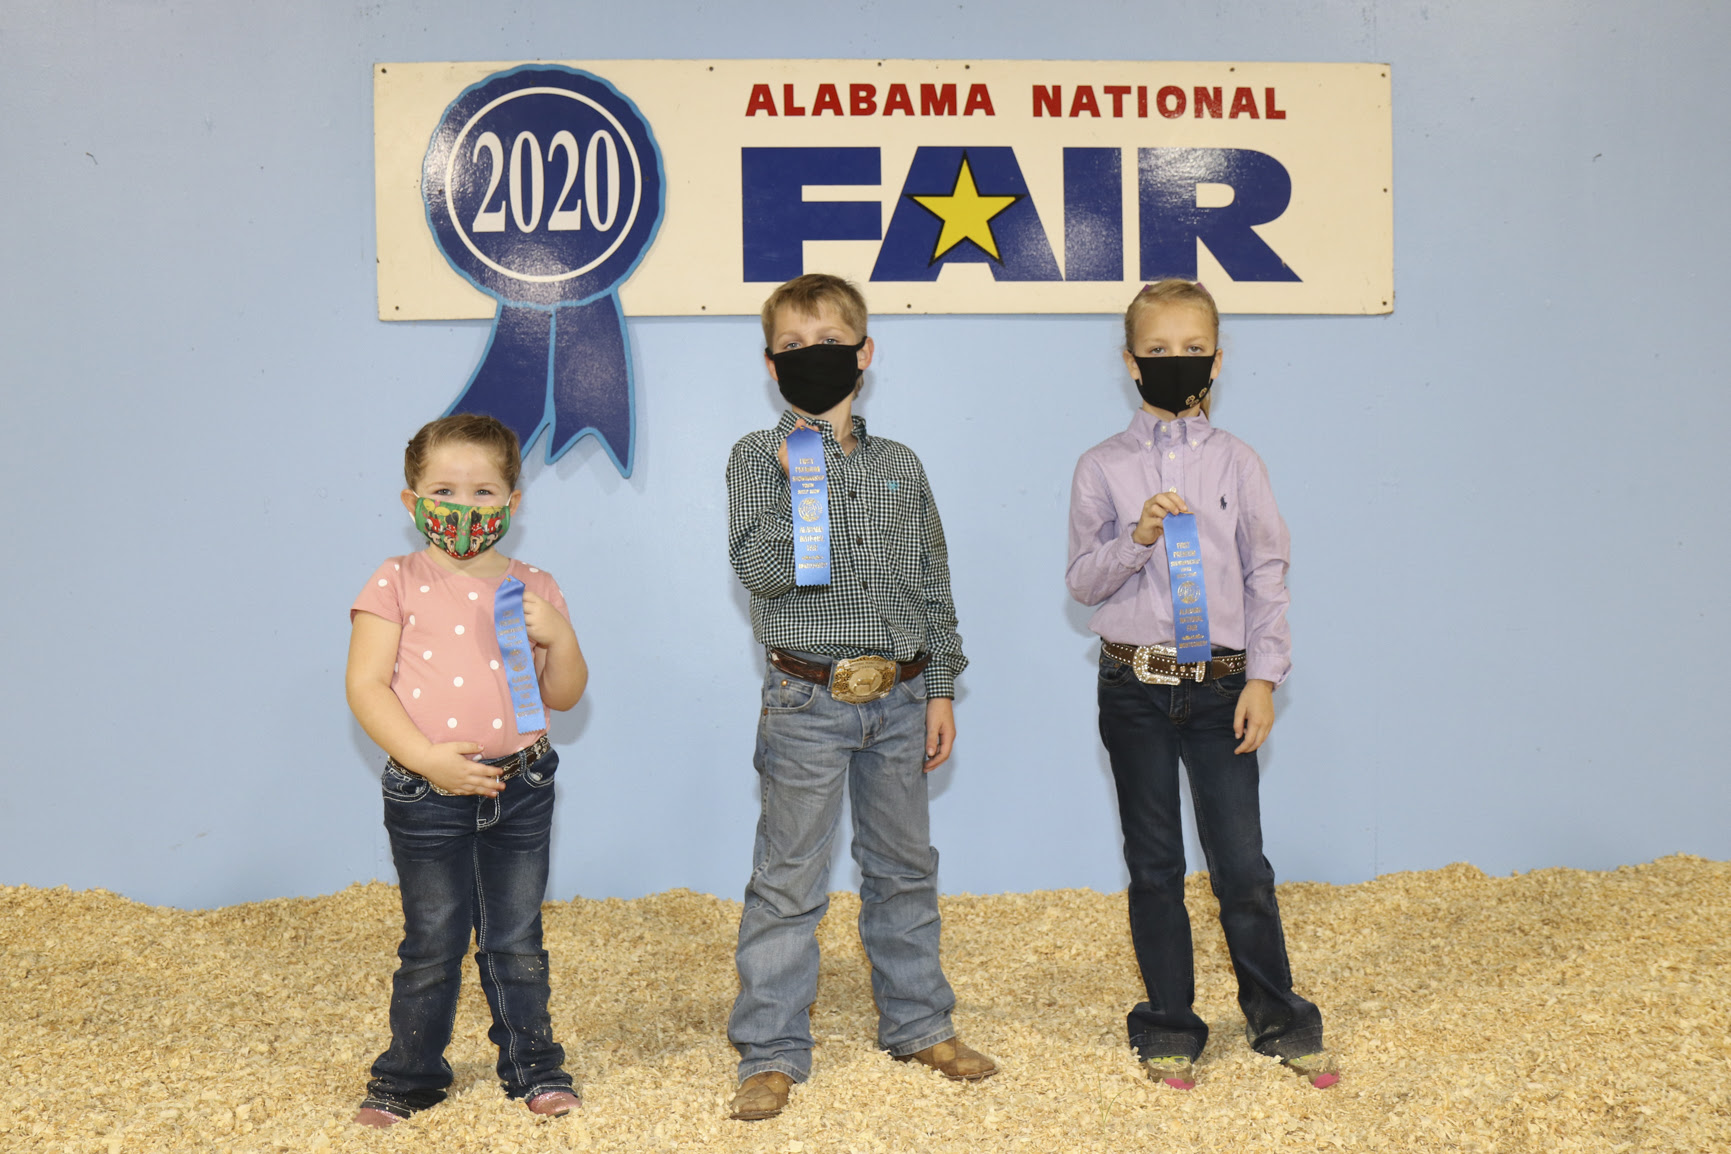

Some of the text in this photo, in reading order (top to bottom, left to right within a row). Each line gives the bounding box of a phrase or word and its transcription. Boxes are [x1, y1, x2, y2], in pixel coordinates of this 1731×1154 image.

[745, 83, 1287, 120] ALABAMA NATIONAL
[472, 130, 620, 234] 2020
[741, 146, 1304, 282] FAIR
